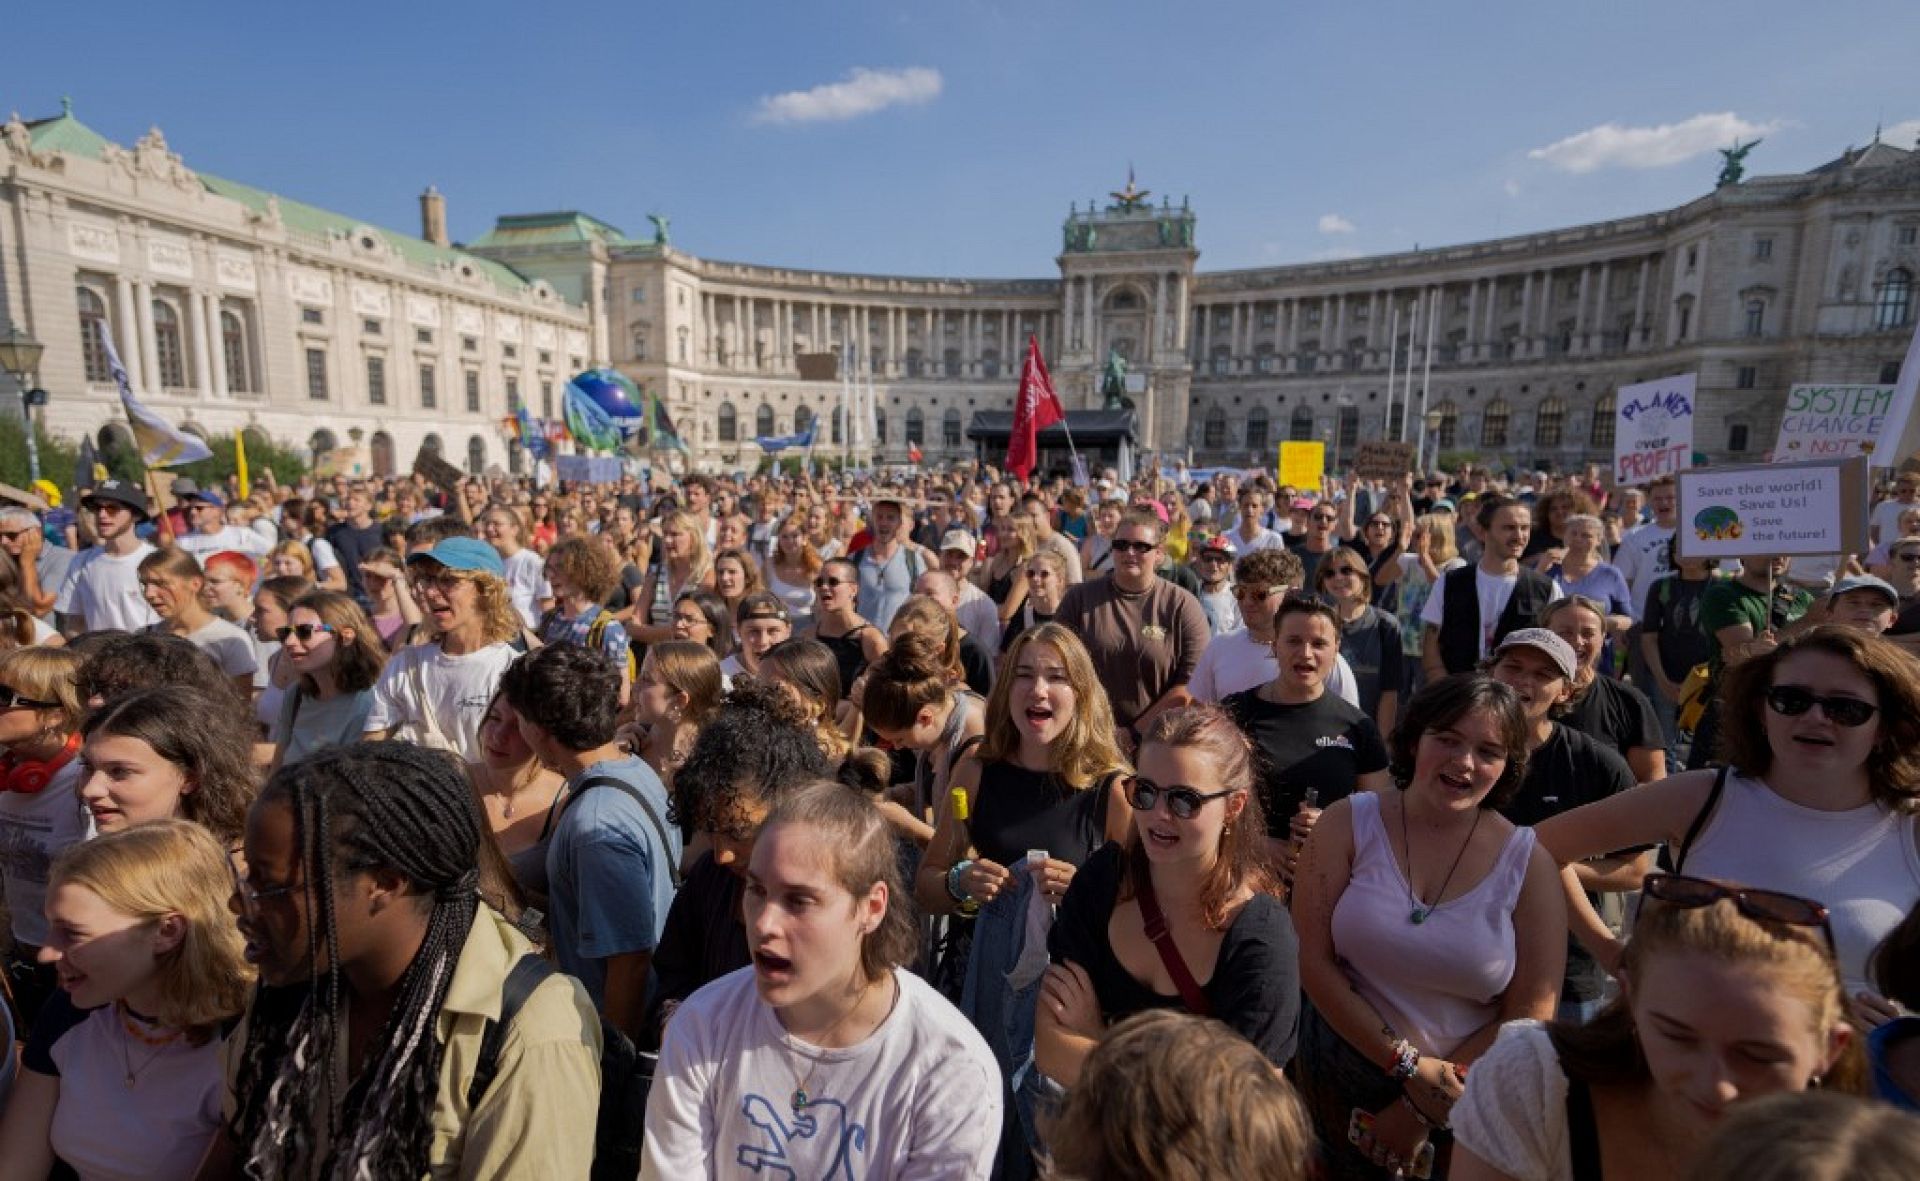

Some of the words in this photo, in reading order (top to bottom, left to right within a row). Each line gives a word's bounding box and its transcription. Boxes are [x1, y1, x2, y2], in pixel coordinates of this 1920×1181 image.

[1622, 389, 1692, 420] PLANET
[1786, 388, 1895, 416] SYSTEM
[1783, 416, 1885, 434] CHANGE
[1635, 437, 1670, 449] over
[1811, 439, 1859, 456] NOT
[1620, 444, 1689, 479] PROFIT
[1697, 486, 1734, 498] Save
[1737, 483, 1765, 495] the
[1769, 480, 1822, 493] world!
[1739, 499, 1777, 511] Save
[1780, 496, 1807, 509] Us!
[1752, 516, 1784, 527] Save
[1752, 531, 1775, 541] the
[1778, 529, 1826, 540] future!
